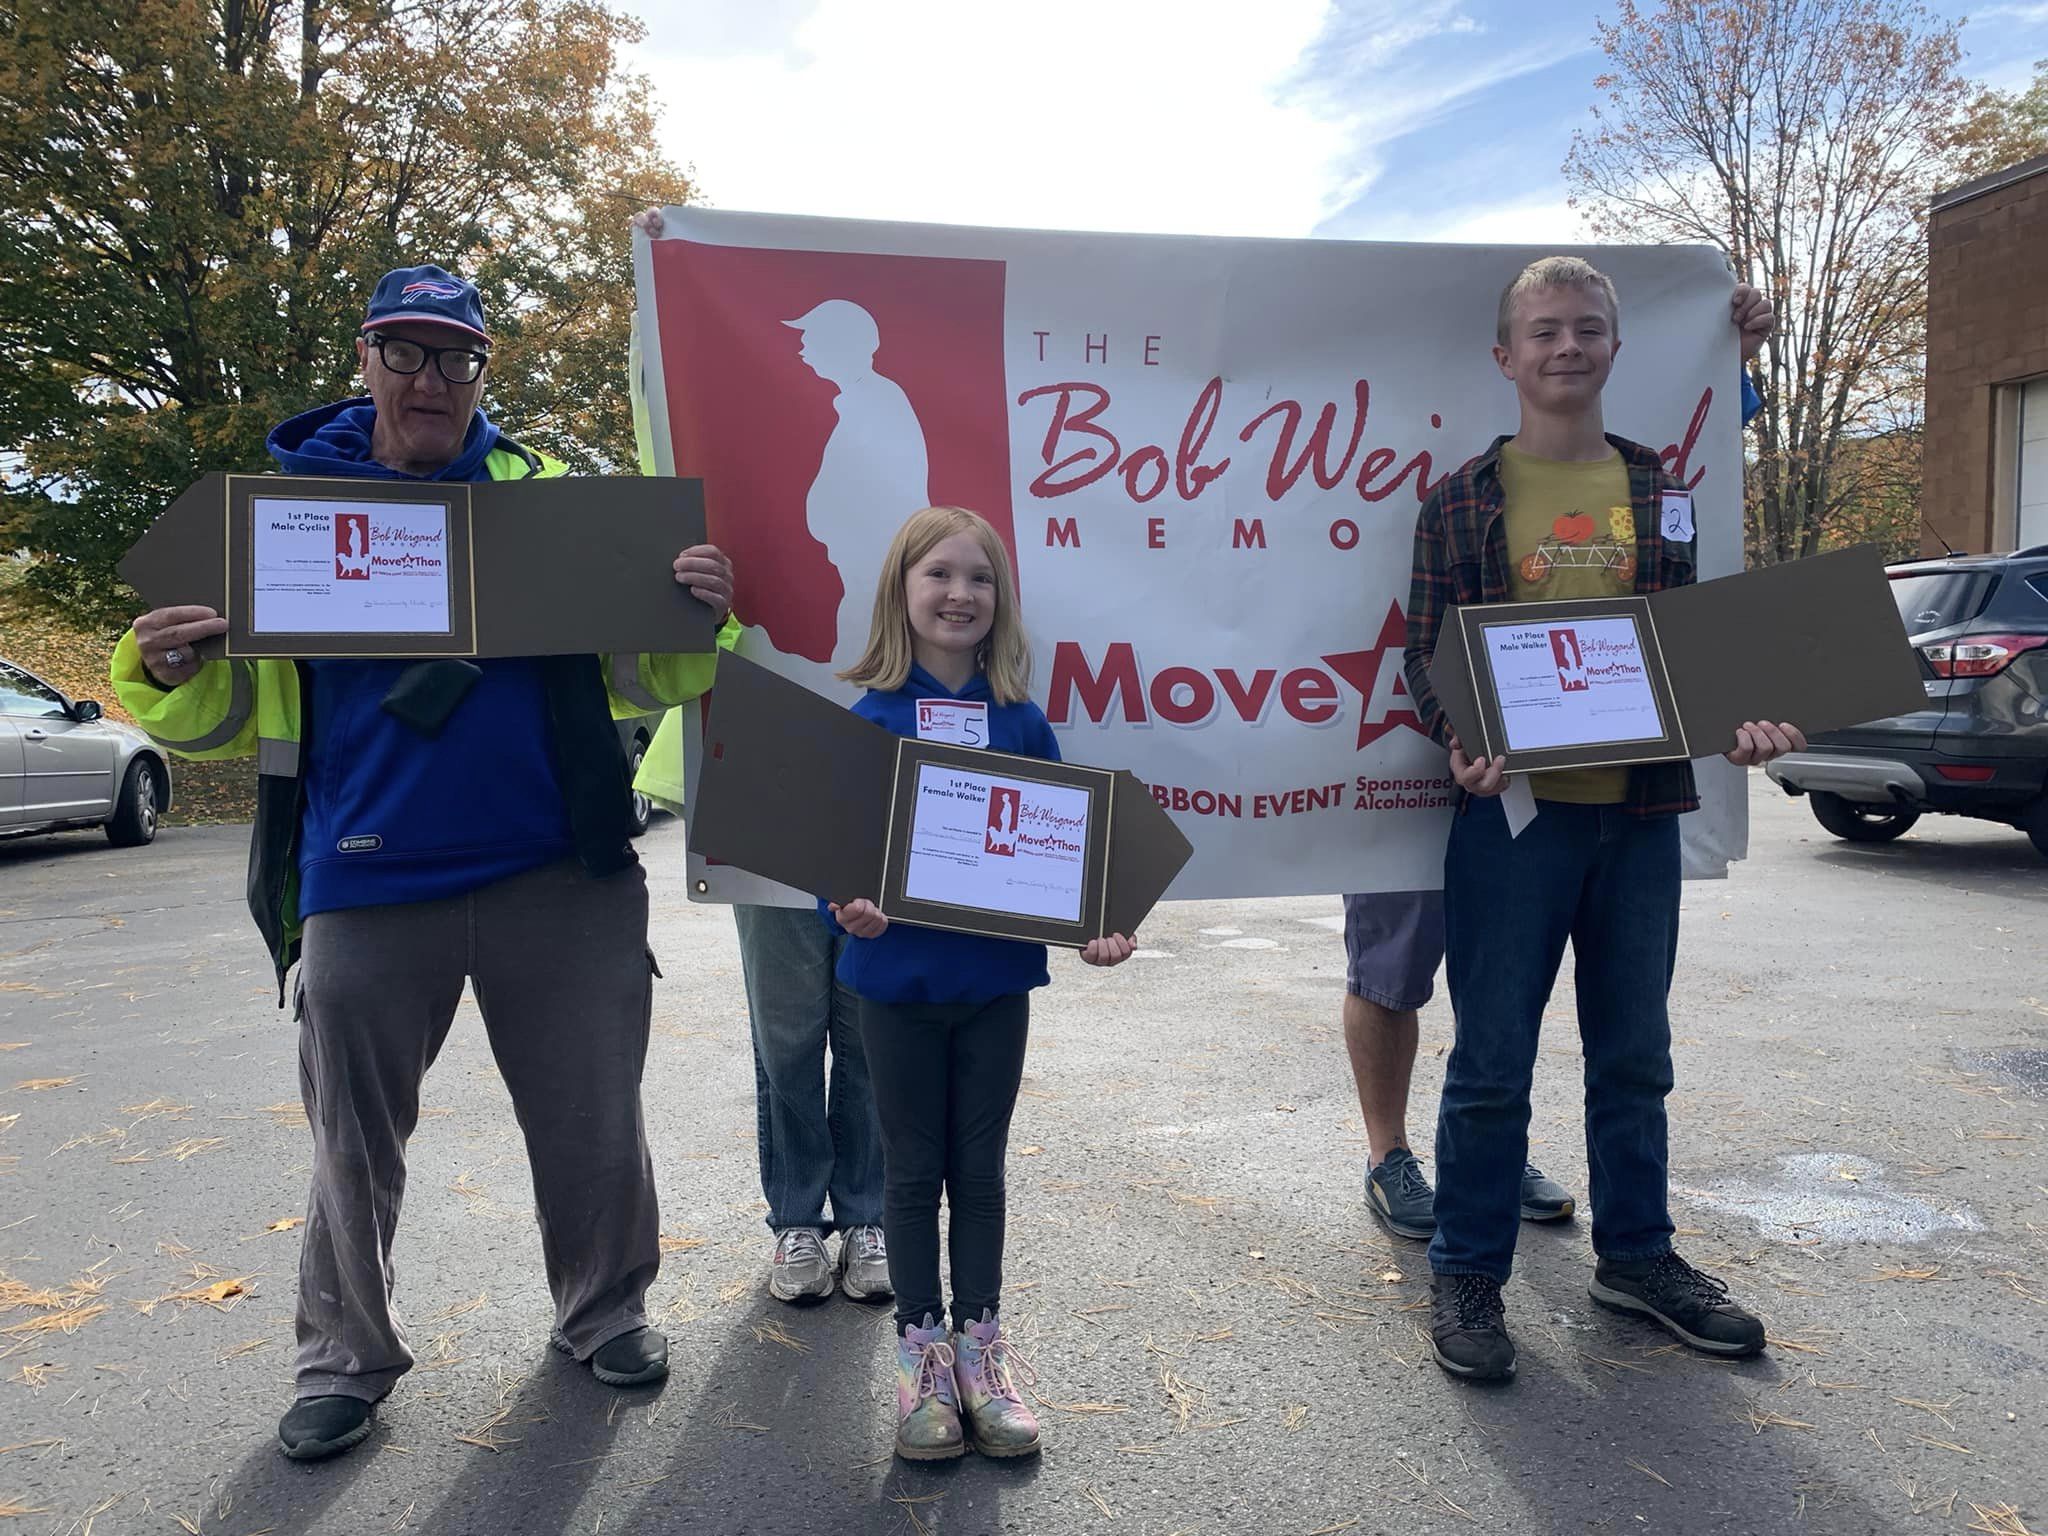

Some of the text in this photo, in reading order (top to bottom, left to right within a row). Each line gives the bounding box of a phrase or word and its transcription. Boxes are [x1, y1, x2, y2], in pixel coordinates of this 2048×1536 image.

[1033, 331, 1161, 365] THE
[1018, 376, 1713, 503] Bob Weid
[271, 522, 330, 533] Male Cyclist
[288, 512, 330, 521] 1st Place
[1668, 508, 1688, 537] 2
[1046, 517, 1360, 550] MEMO
[371, 556, 402, 566] Move
[415, 556, 442, 566] Thon
[1047, 641, 1339, 725] Move
[960, 718, 983, 745] 5
[923, 786, 986, 803] Female Walker
[950, 780, 987, 793] 1st Place
[1144, 784, 1242, 818] BBON
[1253, 783, 1346, 818] EVENT
[1018, 833, 1045, 847] Move
[1057, 839, 1081, 852] Thon
